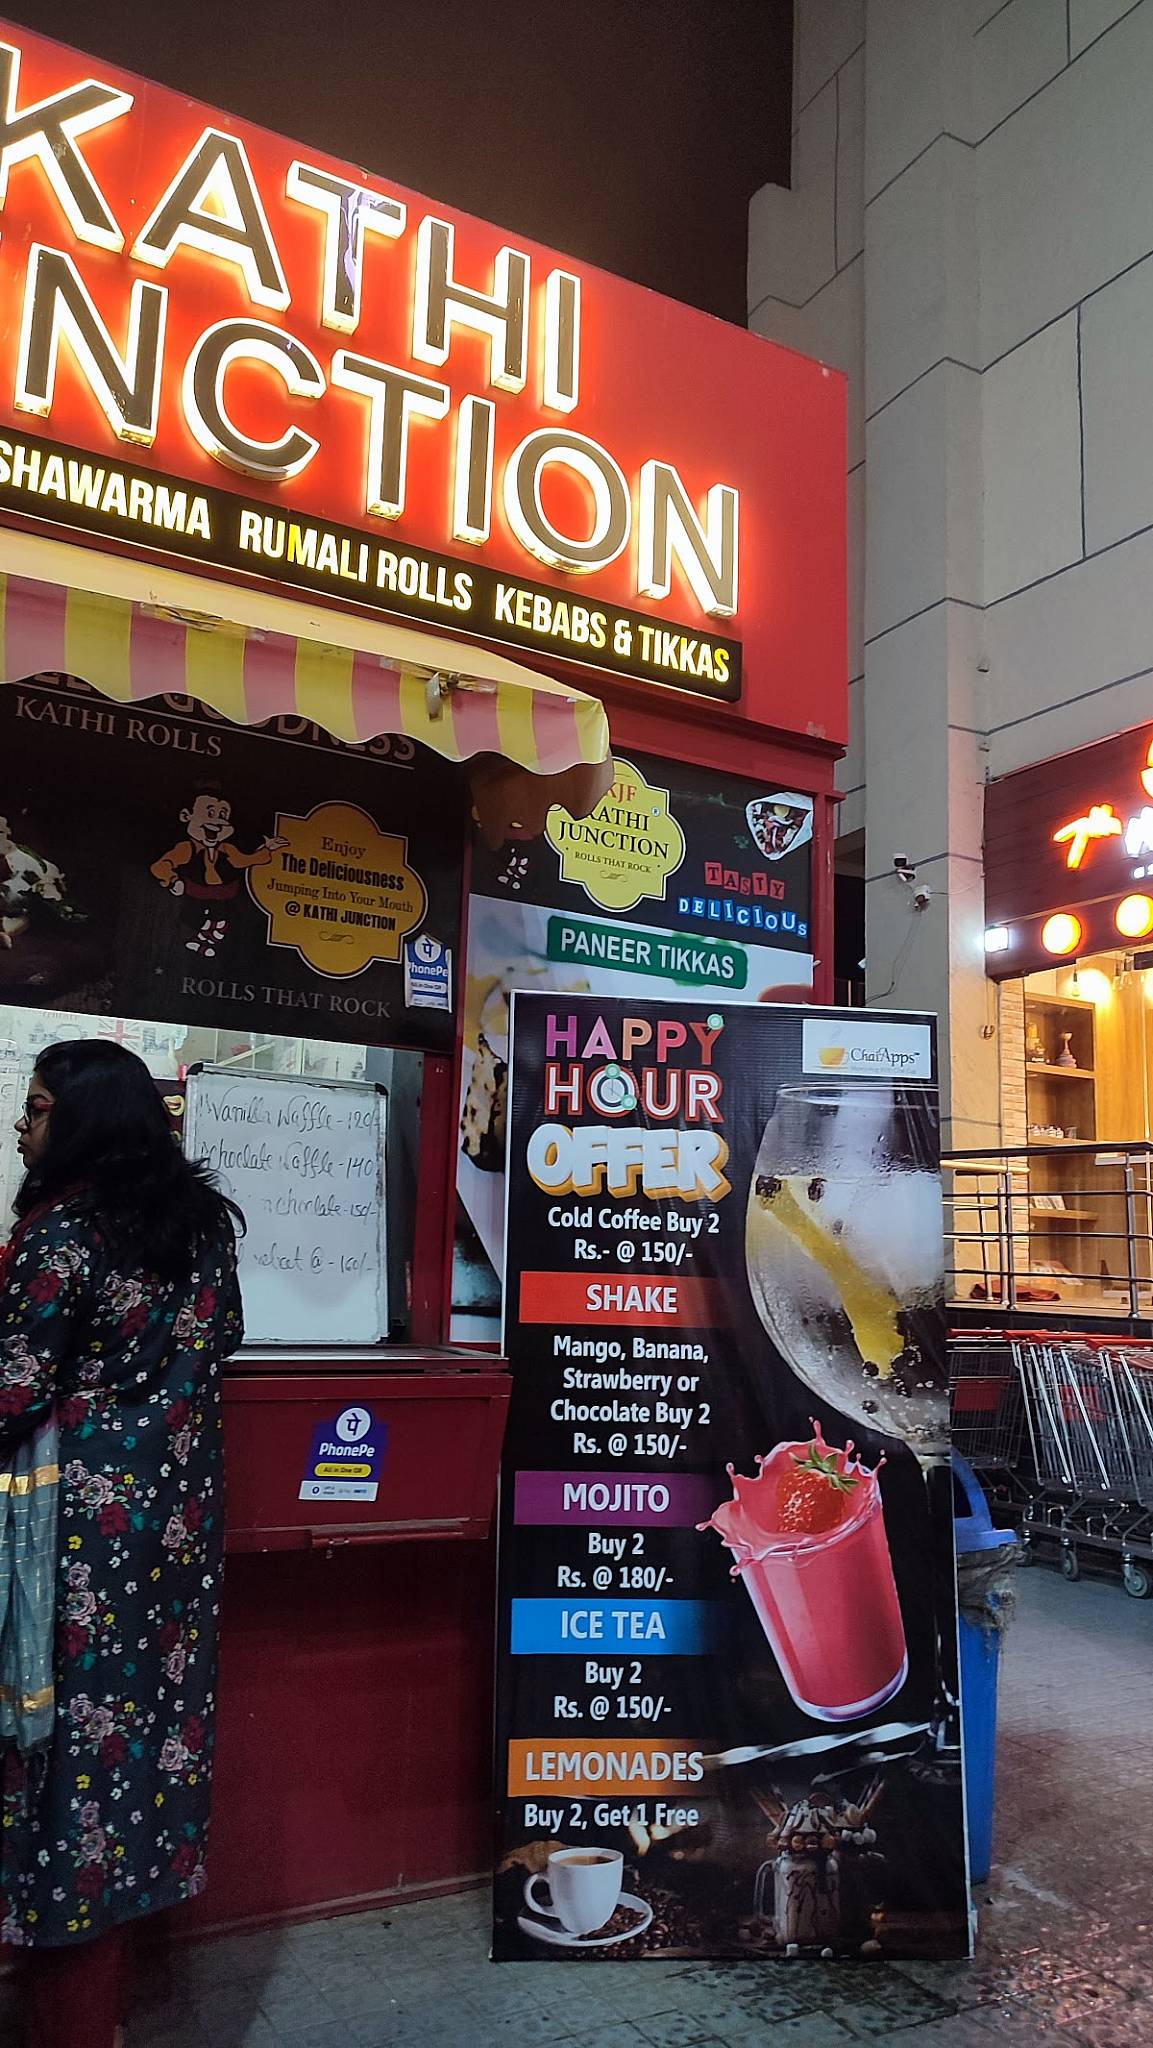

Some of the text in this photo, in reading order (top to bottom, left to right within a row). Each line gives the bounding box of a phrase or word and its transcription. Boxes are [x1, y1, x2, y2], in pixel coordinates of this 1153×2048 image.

[0, 41, 583, 414] KATHI
[0, 439, 731, 684] SHAWARMA RUMALI ROLLS KEBABS & TIKKAS
[16, 696, 115, 736] KATHI
[127, 718, 222, 757] ROLLS
[322, 836, 367, 859] Enjoy
[559, 820, 670, 859] JUNCTION
[282, 852, 405, 891] The Deliciousness
[575, 851, 652, 873] ROLLS THAT ROCK
[267, 878, 414, 913] Jumping Into Your Mouth
[706, 863, 785, 899] TASTY
[285, 900, 396, 931] @ KATHI JUNCTION
[678, 898, 808, 937] DELICIOUS
[561, 927, 735, 979] PANEER TIKKAS
[182, 977, 256, 1001] ROLLS
[262, 987, 324, 1010] THAT
[329, 995, 392, 1018] ROCK
[546, 1014, 726, 1066] HAPPY
[544, 1063, 725, 1123] HOUR
[526, 1123, 732, 1203] OFFER
[548, 1206, 720, 1239] Cold Coffee Buy 2
[616, 1240, 636, 1262] @
[641, 1241, 694, 1265] 150/-
[586, 1283, 678, 1314] SHAKE
[553, 1335, 710, 1363] Mango, Banana,
[563, 1368, 700, 1396] Strawberry or
[550, 1400, 711, 1430] Chocolate Buy 2
[319, 1442, 375, 1457] PhonePe
[573, 1433, 688, 1459] Rs. @ 150/-
[563, 1483, 670, 1513] MOJITO
[588, 1533, 645, 1561] Buy 2
[557, 1566, 674, 1592] Rs. @ 180/-
[561, 1610, 667, 1639] ICE TEA
[585, 1661, 643, 1690] Buy 2
[554, 1696, 672, 1721] Rs. @ 150/-
[525, 1751, 705, 1781] LEMONADES
[524, 1803, 700, 1834] Buy 2, Get 1 Free
